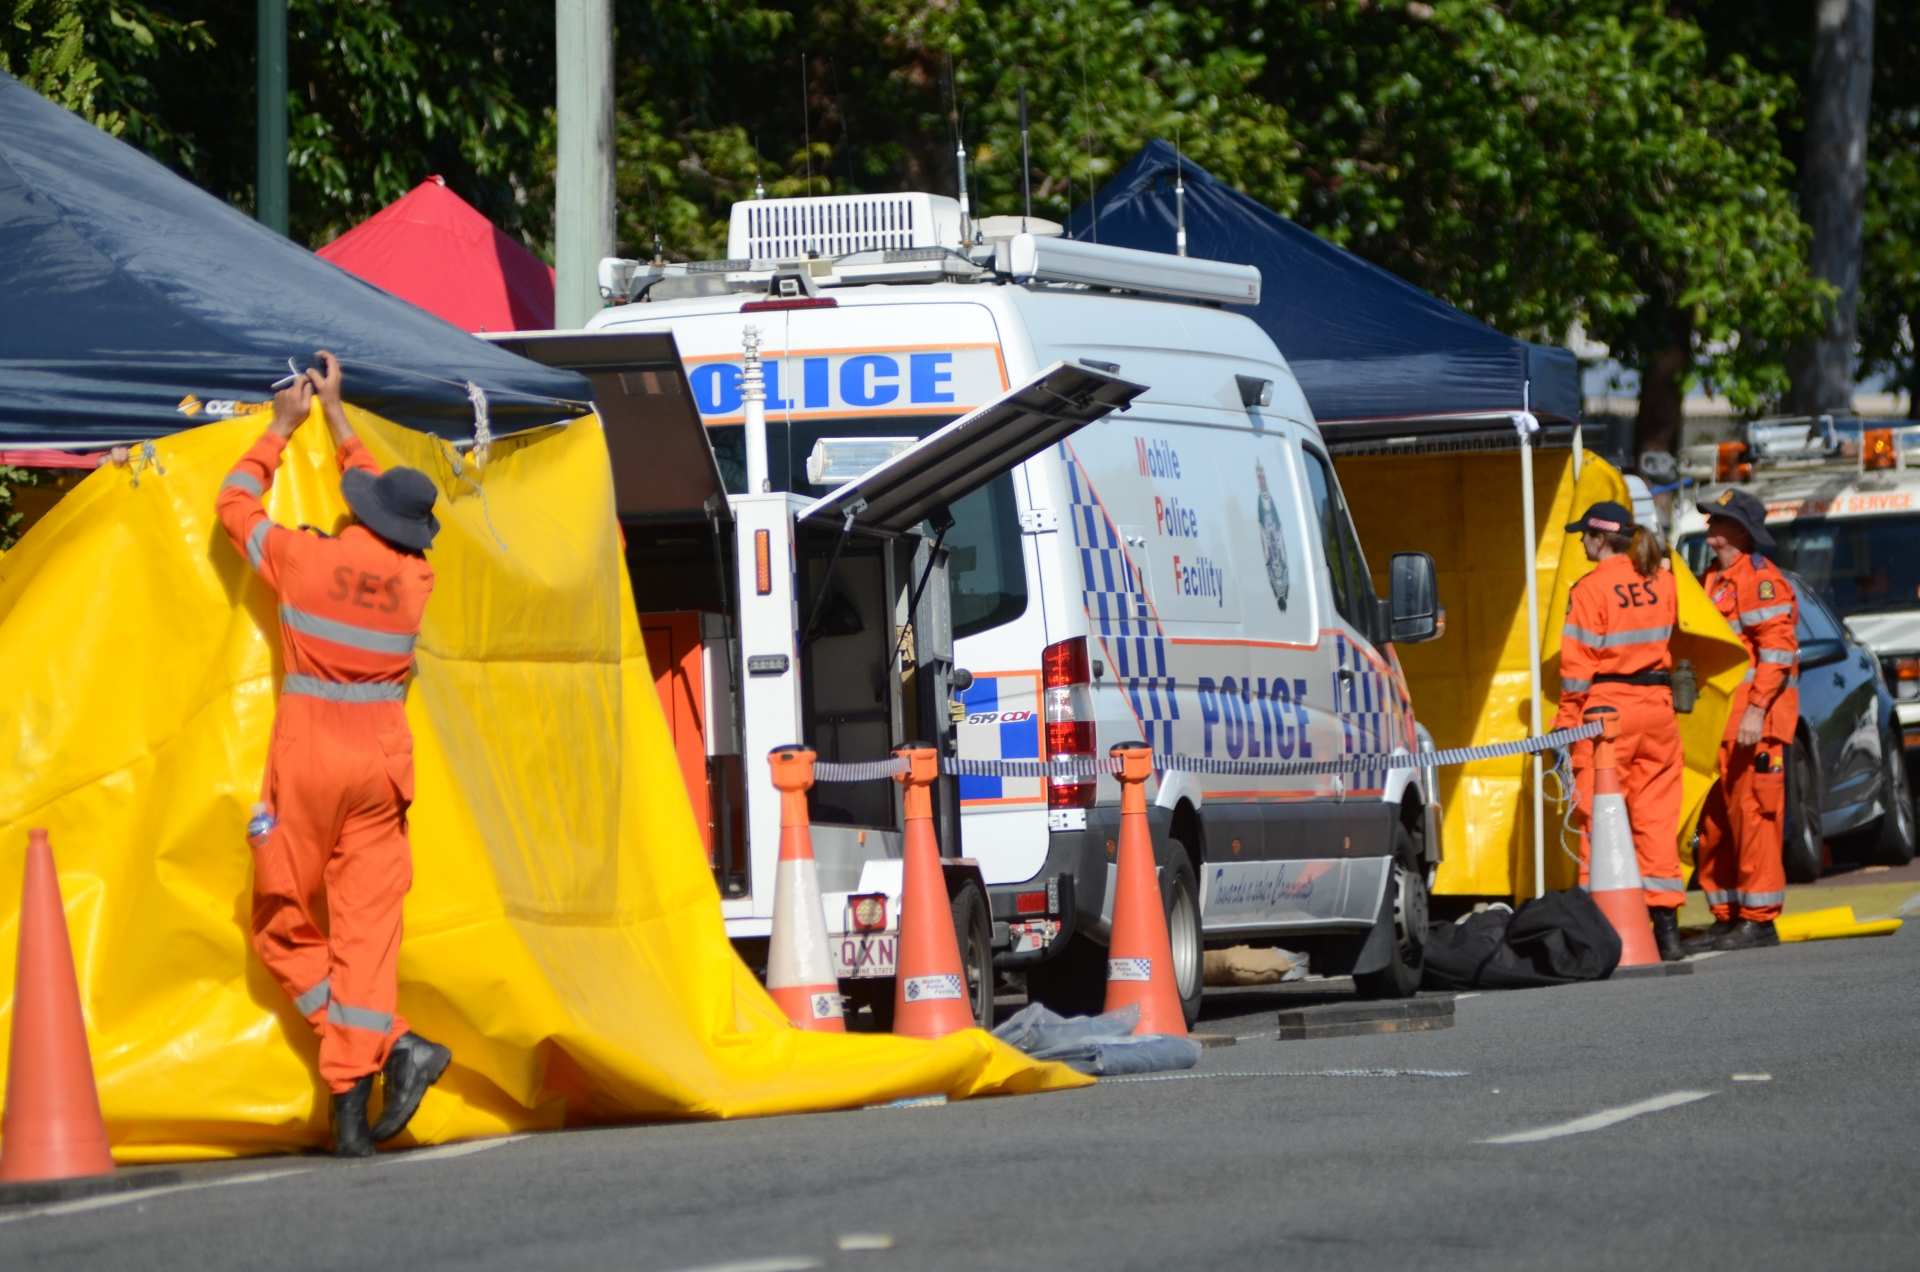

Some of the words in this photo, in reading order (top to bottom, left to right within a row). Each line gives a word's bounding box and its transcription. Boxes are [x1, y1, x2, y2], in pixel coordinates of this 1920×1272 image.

[689, 353, 955, 415] OLICE
[1134, 436, 1181, 480] Mobile
[1154, 495, 1198, 538] Police
[1848, 492, 1912, 513] SERVICE
[327, 565, 401, 615] SES
[1172, 554, 1223, 608] Facility
[1614, 580, 1658, 608] SES
[969, 713, 998, 725] 519
[1001, 710, 1031, 722] CDI
[1197, 675, 1313, 760] POLICE
[842, 939, 894, 967] QXN
